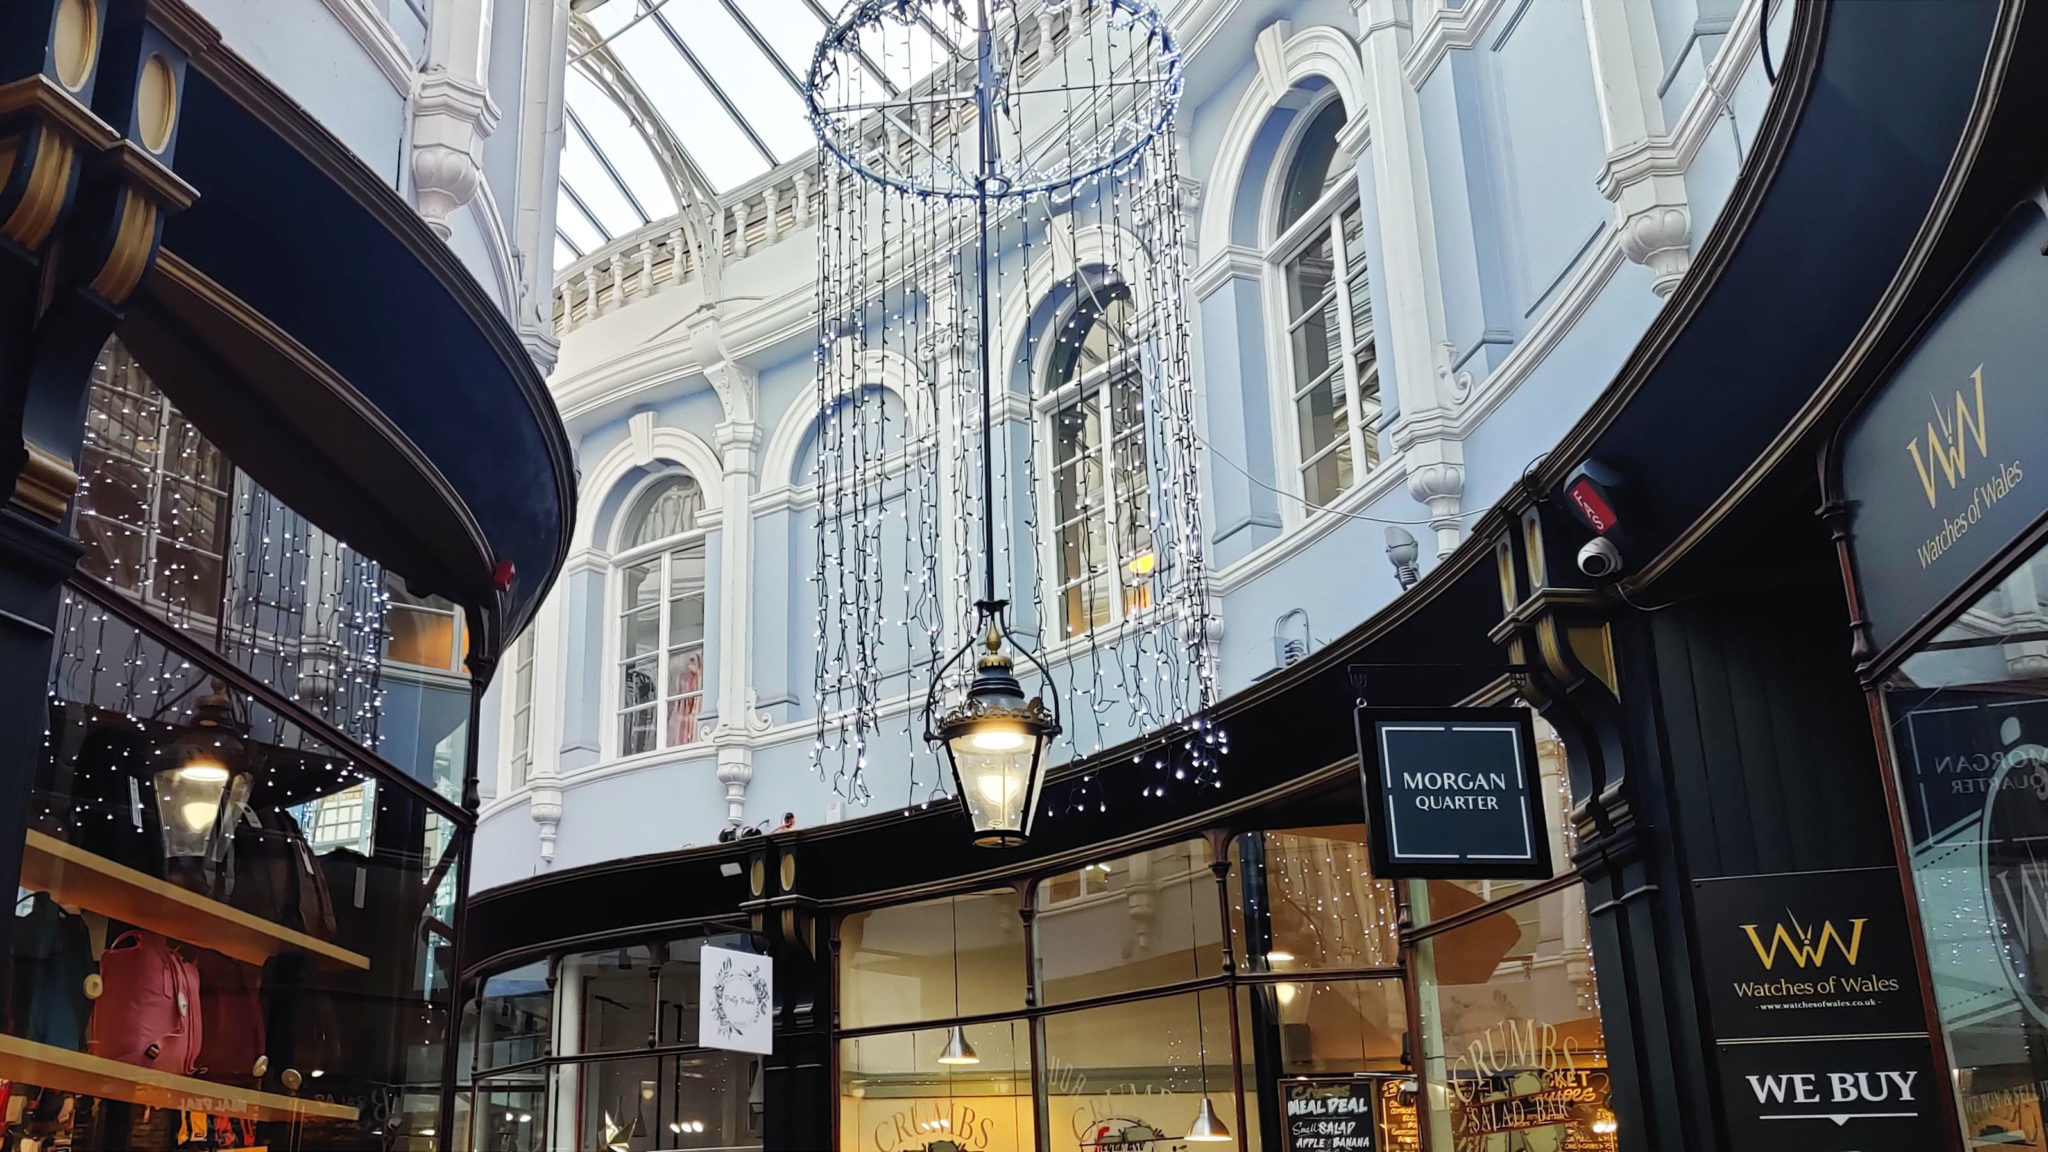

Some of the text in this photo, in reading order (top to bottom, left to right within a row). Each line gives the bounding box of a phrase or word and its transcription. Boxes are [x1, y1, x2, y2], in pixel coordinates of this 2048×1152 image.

[1917, 460, 2023, 570] Watches of Wales
[1403, 772, 1506, 791] MORGAN
[1415, 795, 1499, 811] QUARTER
[1733, 974, 1899, 998] Watches of Wales
[1760, 998, 1876, 1010] www.watchesofwales.co.uk
[1452, 1018, 1578, 1103] CRUMBS
[1745, 1071, 1918, 1104] WE BUY
[1287, 1097, 1368, 1116] MEAL DEAL
[1471, 1091, 1570, 1133] SALAD BAR
[874, 1100, 994, 1152] CRUMBS
[1318, 1121, 1356, 1135] SALAD
[1296, 1138, 1325, 1149] APPLE
[1332, 1137, 1370, 1151] BANANA
